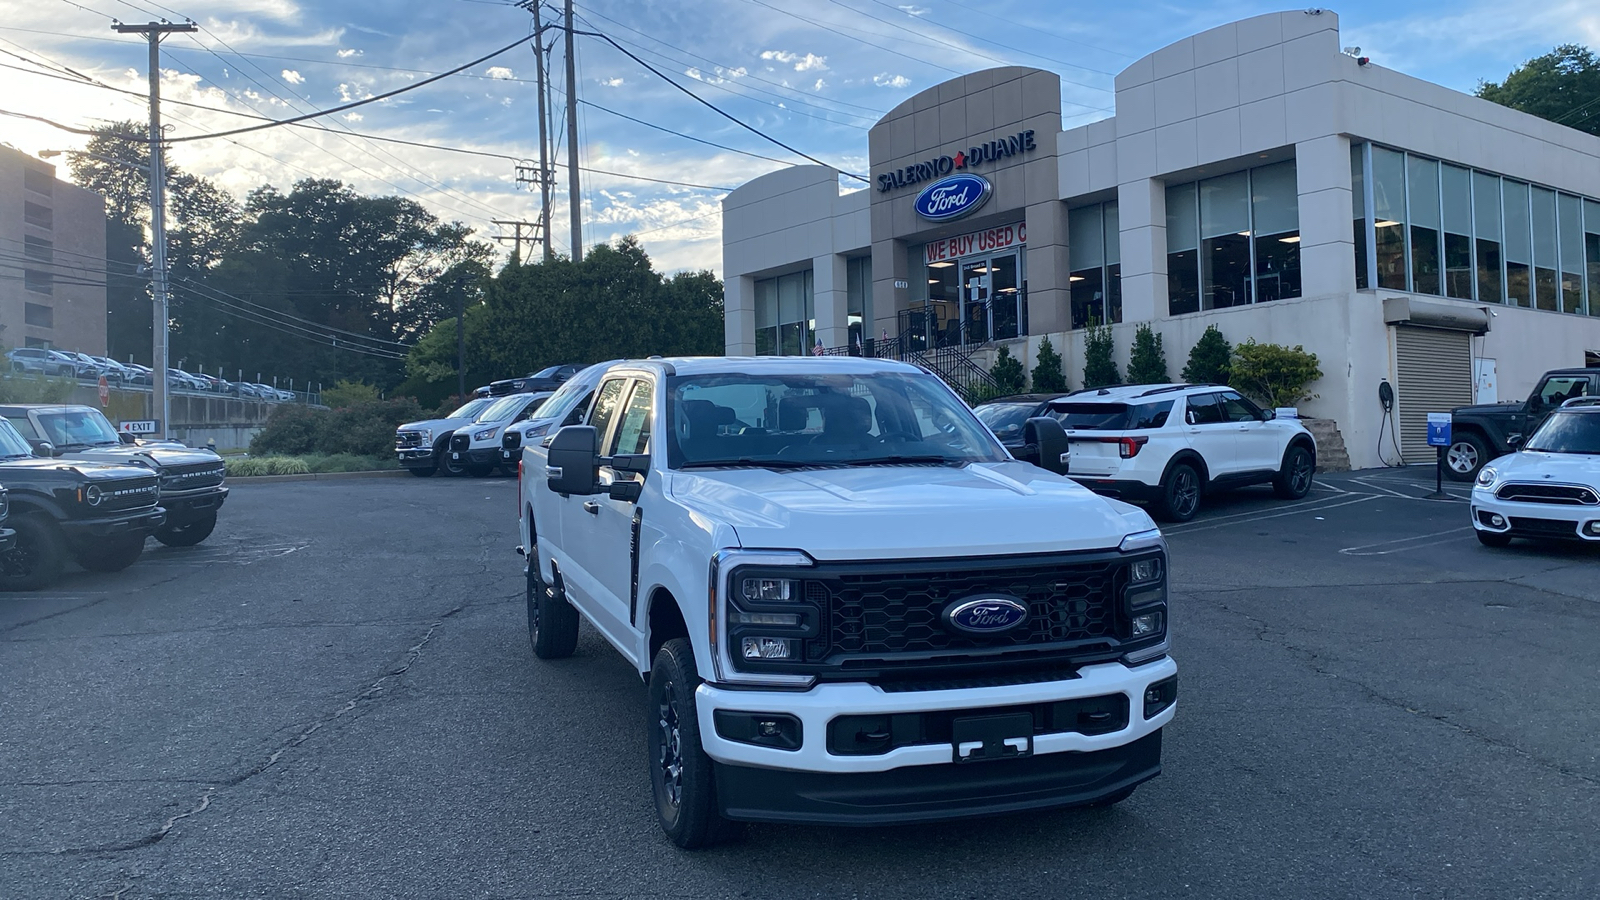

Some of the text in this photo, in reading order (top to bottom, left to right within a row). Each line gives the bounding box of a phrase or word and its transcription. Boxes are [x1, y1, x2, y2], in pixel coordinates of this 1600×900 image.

[877, 129, 1037, 193] SALERNO DUANE
[927, 184, 969, 214] Ford
[926, 241, 946, 262] WE
[949, 234, 975, 257] BUY
[978, 226, 1014, 251] USED
[132, 422, 151, 431] EXIT
[182, 470, 217, 478] BRONCO
[114, 486, 153, 496] BRONCO
[969, 606, 1010, 626] Ford
